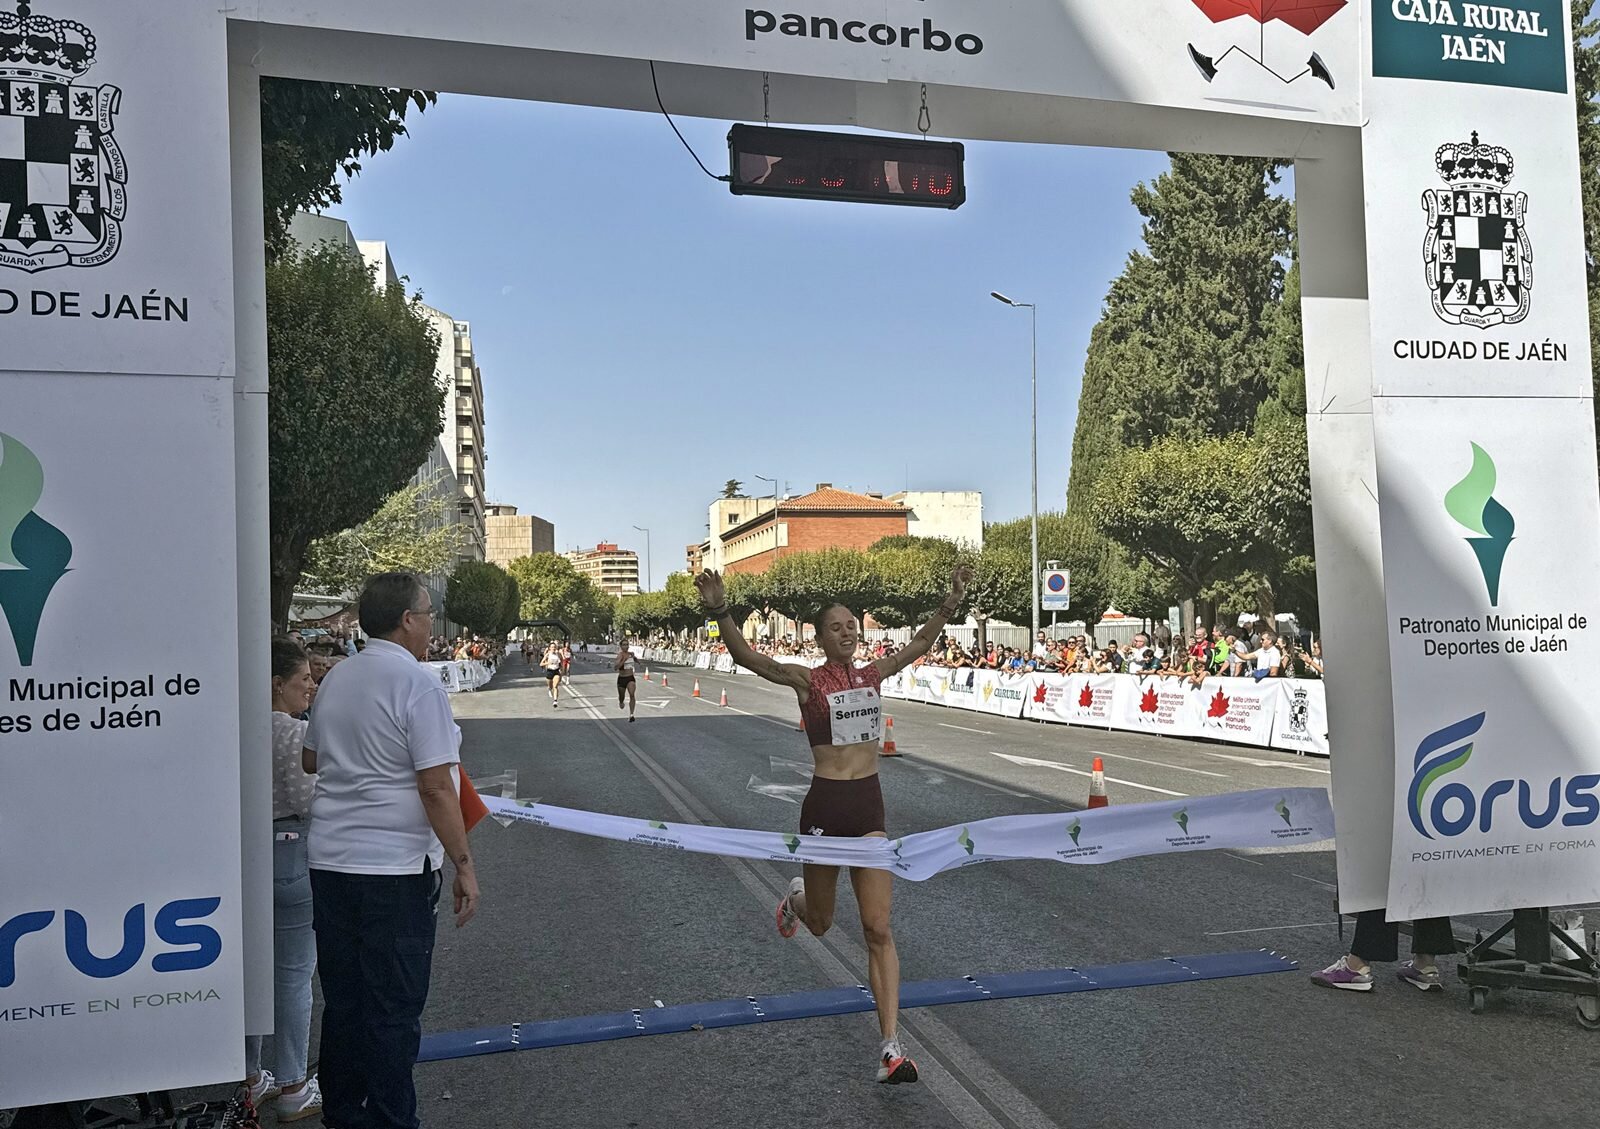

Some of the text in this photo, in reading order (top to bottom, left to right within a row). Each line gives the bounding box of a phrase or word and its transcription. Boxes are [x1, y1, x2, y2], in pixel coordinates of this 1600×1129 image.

[1392, 0, 1548, 37] CAJA RURAL
[745, 9, 984, 55] pancorbo
[1441, 34, 1506, 64] JAÉN
[100, 92, 110, 128] CASTILLA
[102, 135, 113, 148] DE
[113, 188, 122, 216] DE LOS
[31, 290, 80, 317] DE
[91, 289, 188, 322] JAÉN
[1394, 338, 1567, 361] CIUDAD DE JAÉN
[1400, 613, 1587, 634] Patronato Municipal de
[1424, 634, 1568, 659] Deportes de Jaén
[10, 673, 200, 704] Municipal de
[834, 695, 844, 704] 37
[43, 708, 80, 730] de
[90, 704, 161, 729] Jaén
[836, 706, 878, 720] Serrano
[1226, 723, 1251, 731] Pancorbo
[1412, 840, 1596, 862] POSITIVAMENTE EN FORMA
[88, 998, 120, 1013] EN
[133, 989, 220, 1008] FORMA
